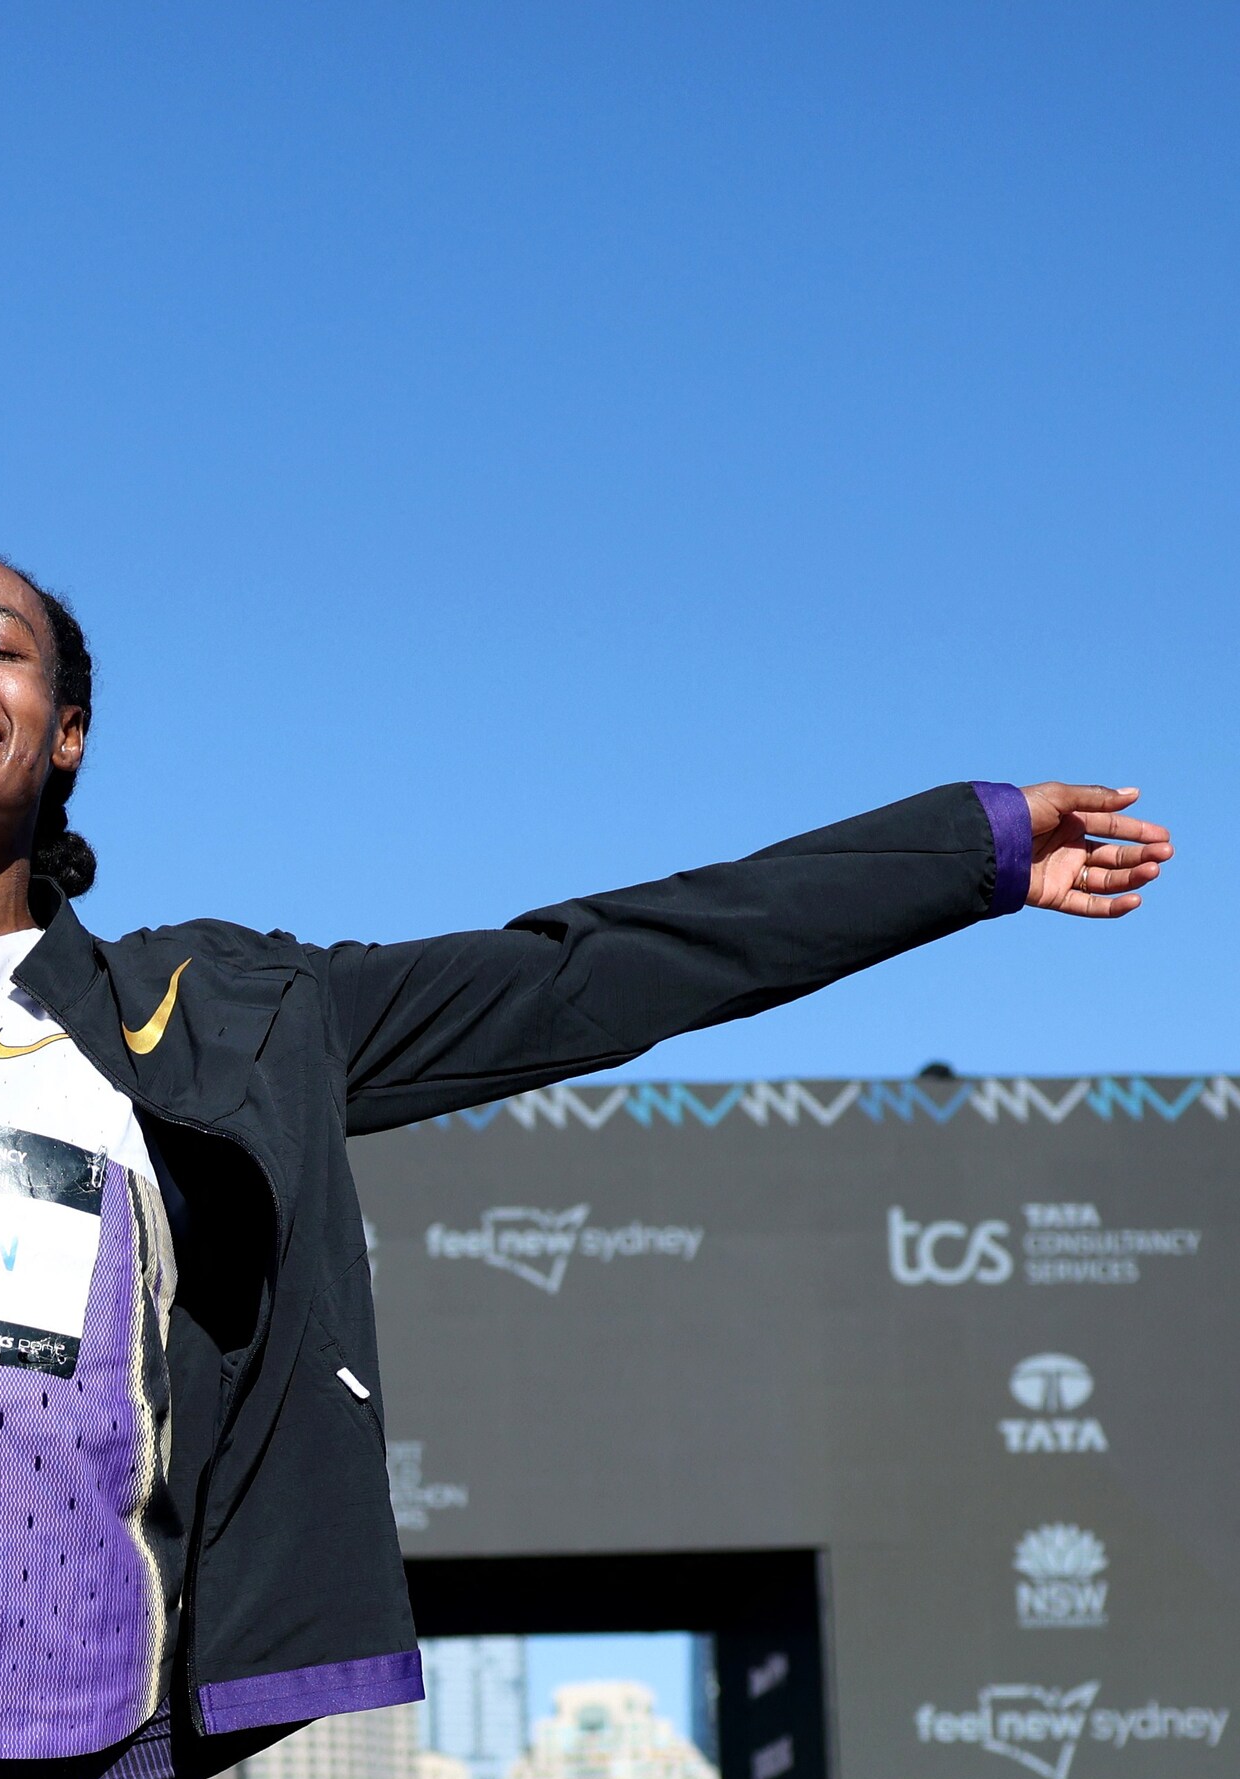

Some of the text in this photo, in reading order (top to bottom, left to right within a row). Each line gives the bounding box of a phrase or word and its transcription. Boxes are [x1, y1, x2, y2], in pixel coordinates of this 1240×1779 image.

[1022, 1203, 1101, 1228] TATA
[580, 1220, 705, 1262] sydney
[888, 1205, 1014, 1286] tcs
[1023, 1229, 1201, 1256] CONSULTANCY
[1024, 1258, 1141, 1284] SERVICES
[997, 1418, 1109, 1452] TATA
[1016, 1581, 1108, 1618] NSW
[1090, 1699, 1229, 1748] sydney
